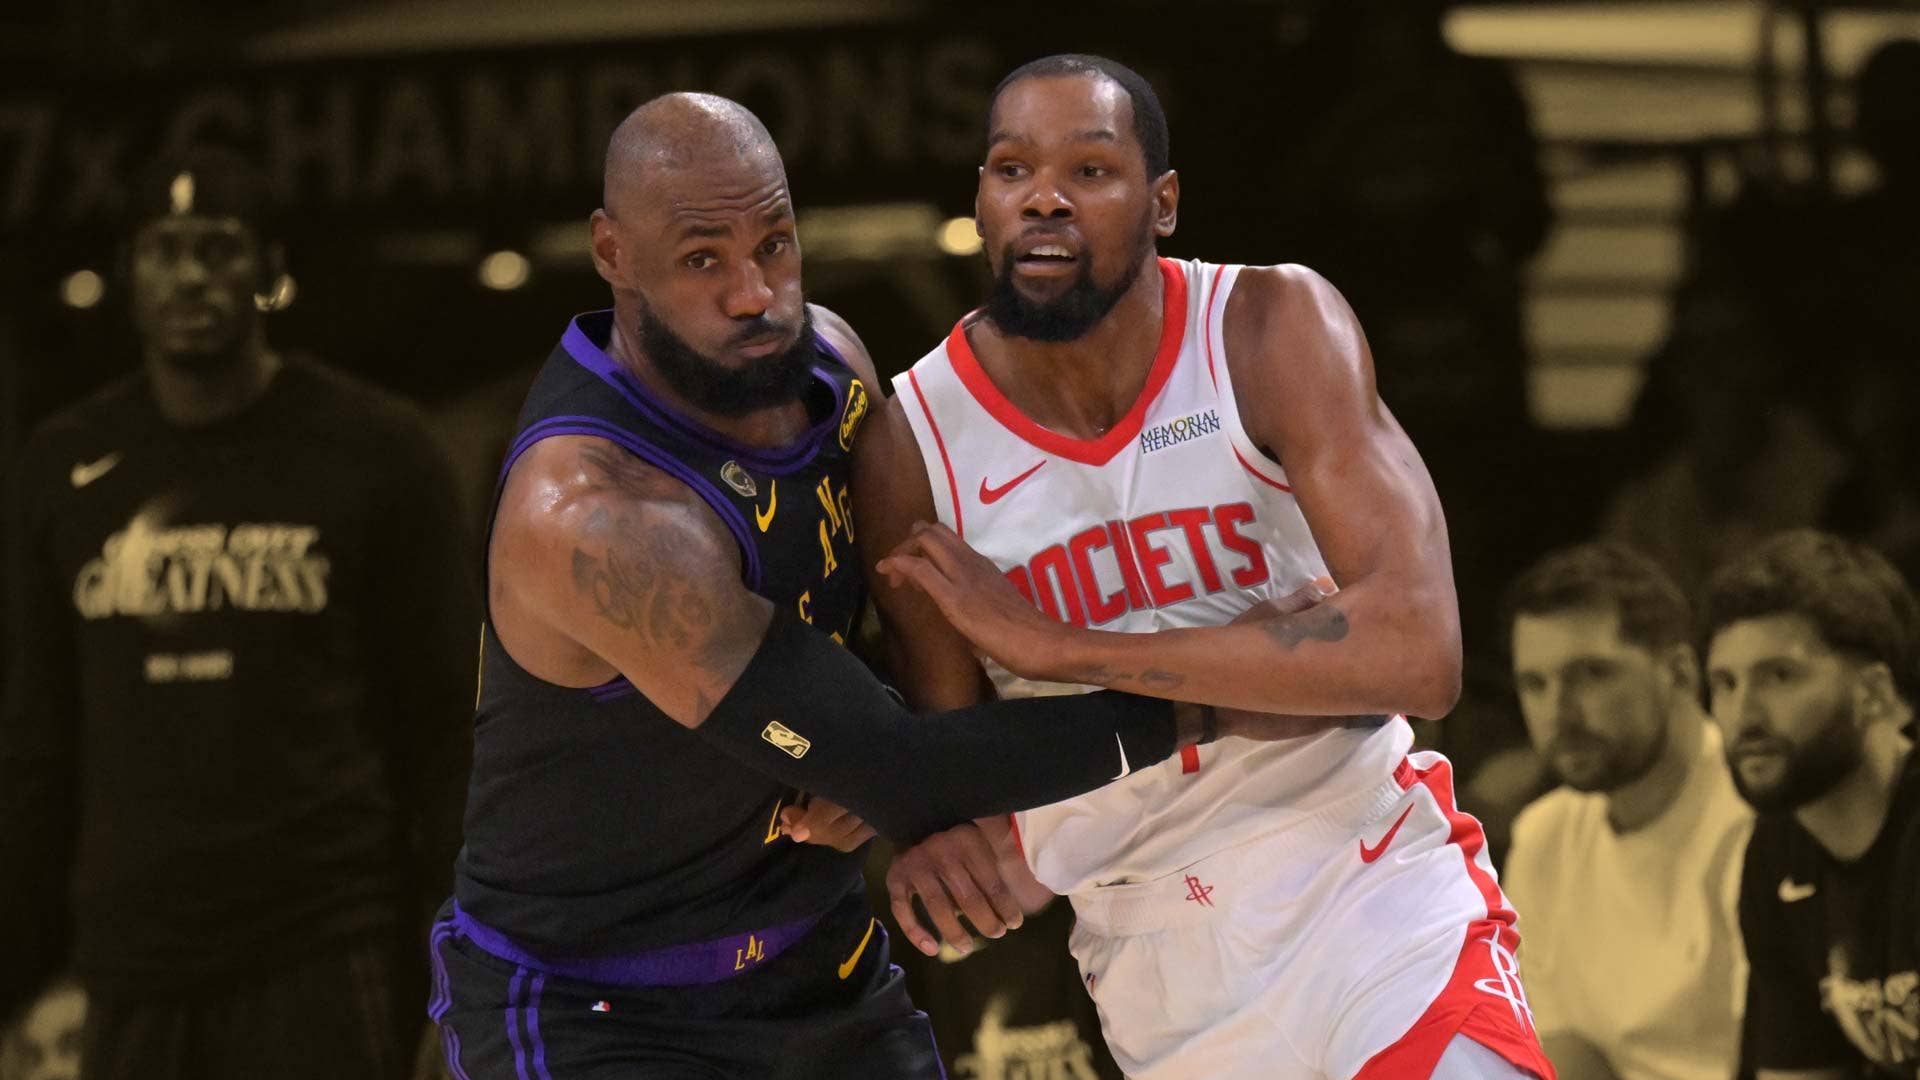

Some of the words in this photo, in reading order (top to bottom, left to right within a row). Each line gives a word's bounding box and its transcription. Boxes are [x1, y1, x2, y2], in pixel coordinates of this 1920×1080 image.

[166, 46, 990, 194] CHAMPONS
[1140, 409, 1220, 443] MEMORIAL
[1141, 420, 1221, 454] HERMANN
[73, 553, 331, 621] GEATNESS
[734, 935, 765, 971] LAL
